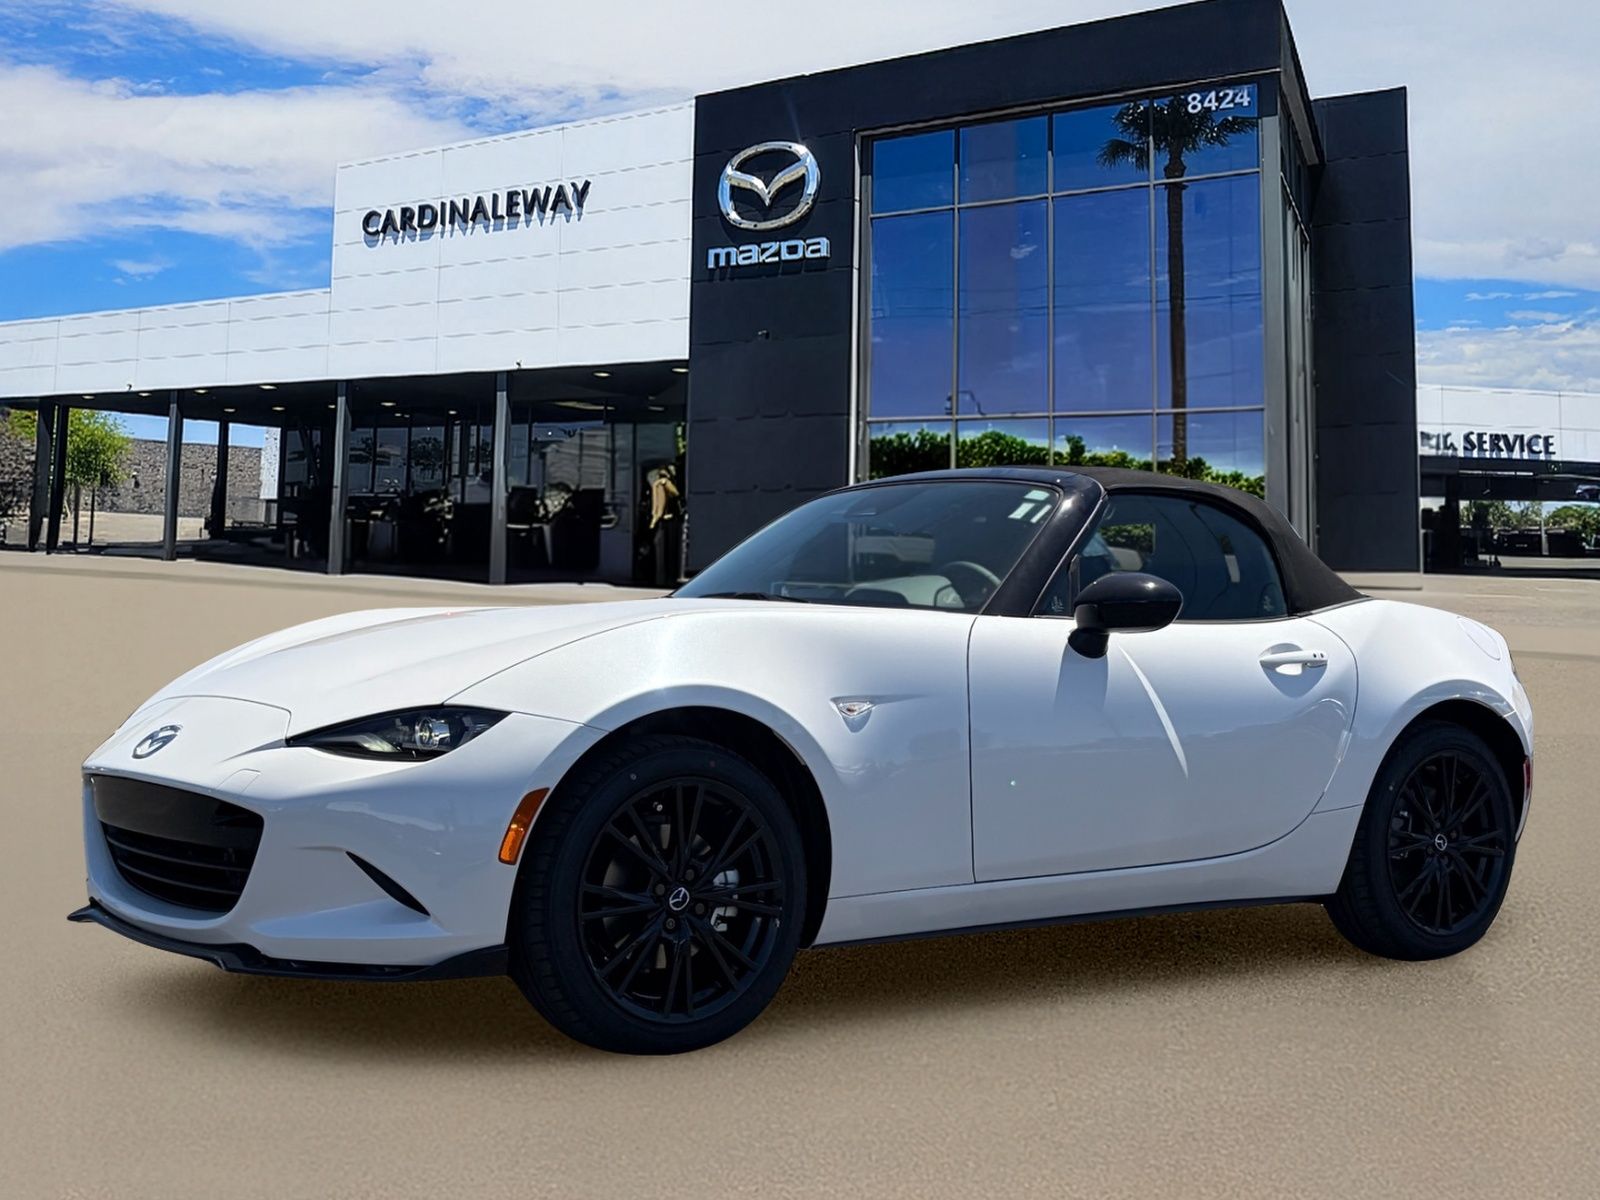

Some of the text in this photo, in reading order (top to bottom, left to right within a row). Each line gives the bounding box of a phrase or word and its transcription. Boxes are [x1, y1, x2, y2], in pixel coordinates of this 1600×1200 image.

[1187, 88, 1251, 114] 8424
[362, 179, 591, 236] CARDINALEWAY
[1462, 431, 1556, 455] SERVICE
